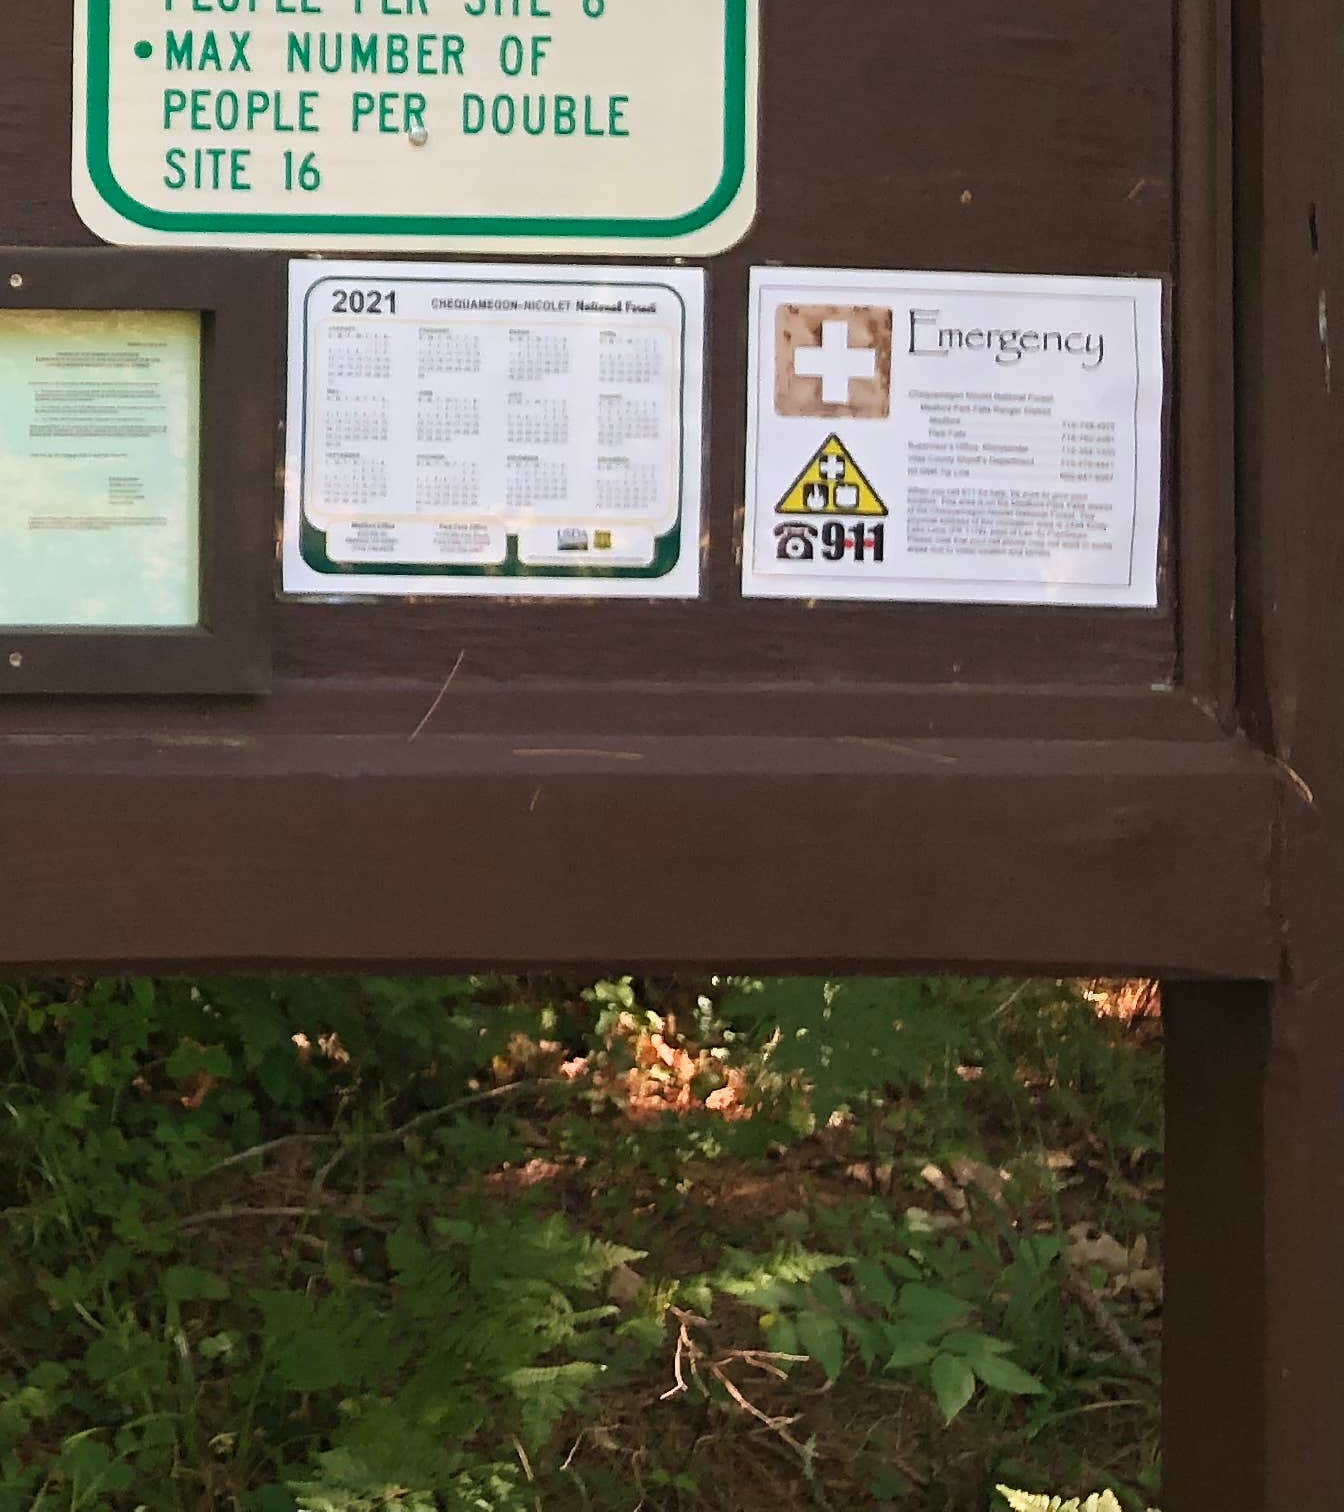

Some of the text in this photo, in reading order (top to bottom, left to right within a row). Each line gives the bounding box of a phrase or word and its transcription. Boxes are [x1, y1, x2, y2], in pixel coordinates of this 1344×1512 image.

[332, 290, 395, 314] 2021
[909, 309, 1104, 371] Emergency
[822, 522, 884, 562] 911
